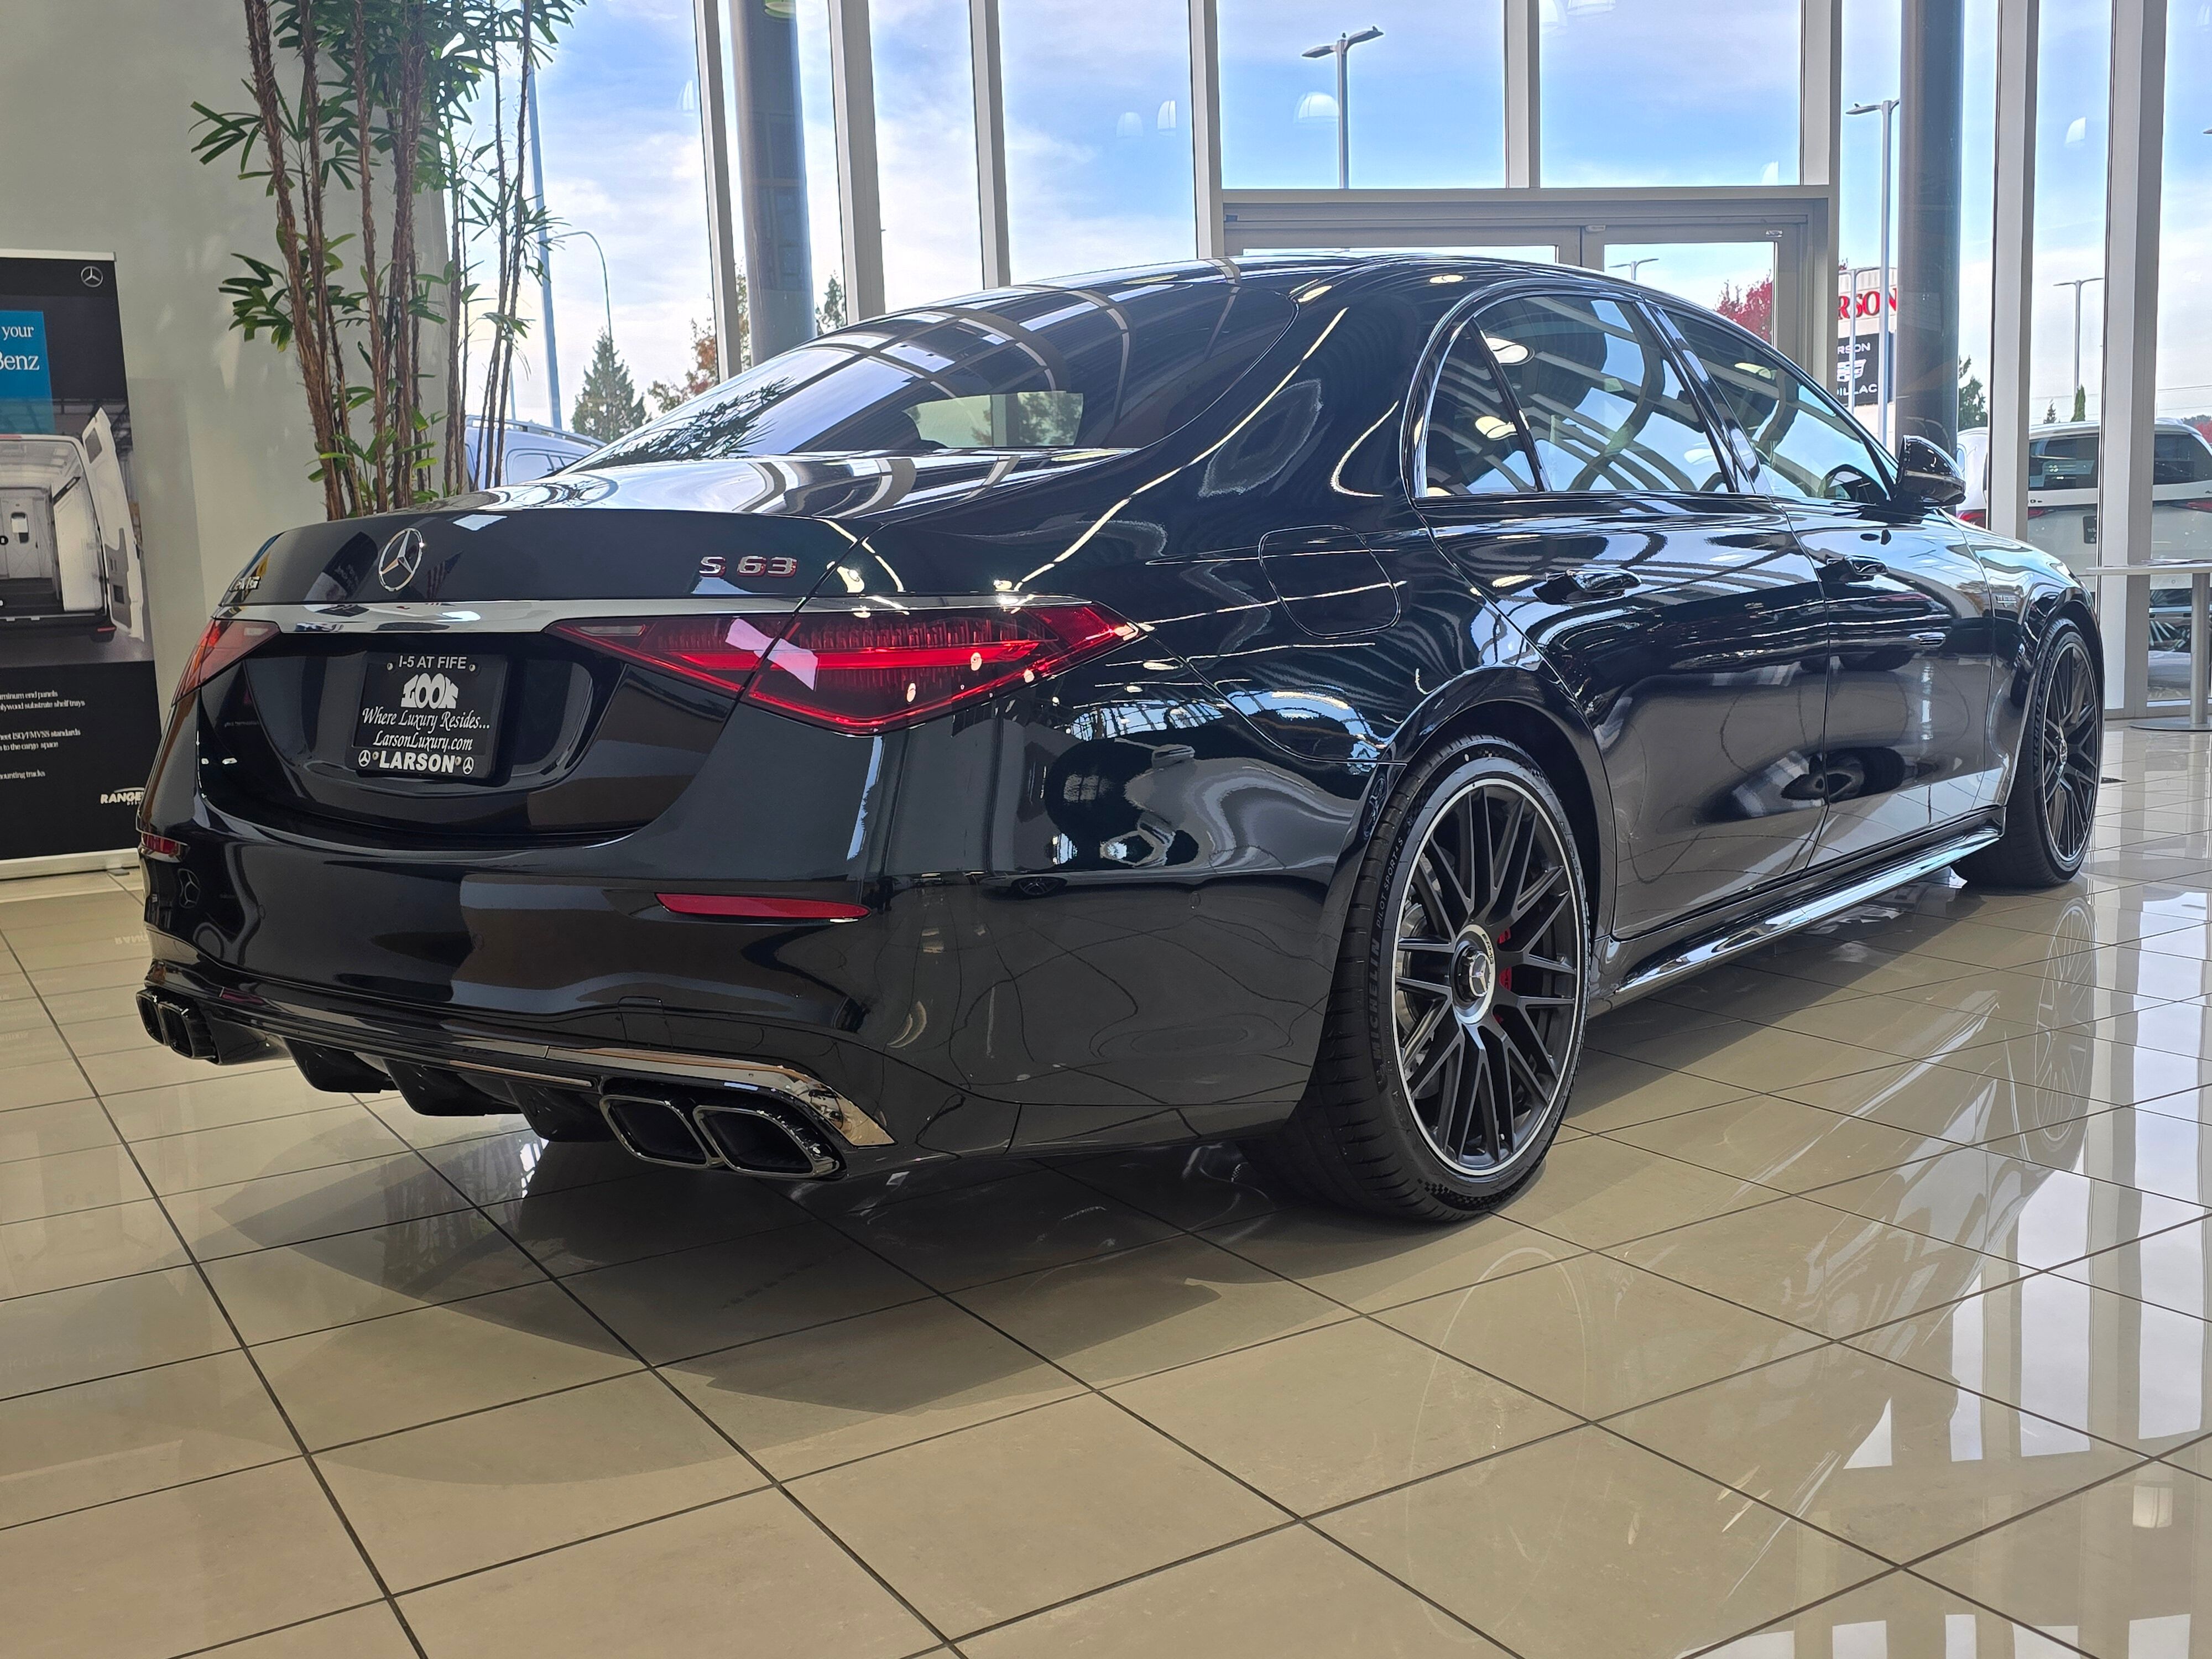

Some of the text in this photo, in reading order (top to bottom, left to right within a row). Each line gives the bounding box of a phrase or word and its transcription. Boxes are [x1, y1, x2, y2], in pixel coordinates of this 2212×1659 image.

[2, 326, 34, 341] your
[700, 556, 798, 577] S 63
[399, 655, 467, 669] I-5 AT FIFE
[362, 706, 397, 725] Where
[398, 709, 438, 734] Luxury
[373, 731, 473, 753] LarsonLuxury.com
[379, 751, 455, 773] LARSON
[1369, 938, 1381, 1061] MICHELIN
[1376, 893, 1386, 929] PILOT
[1384, 853, 1397, 891] SPORT
